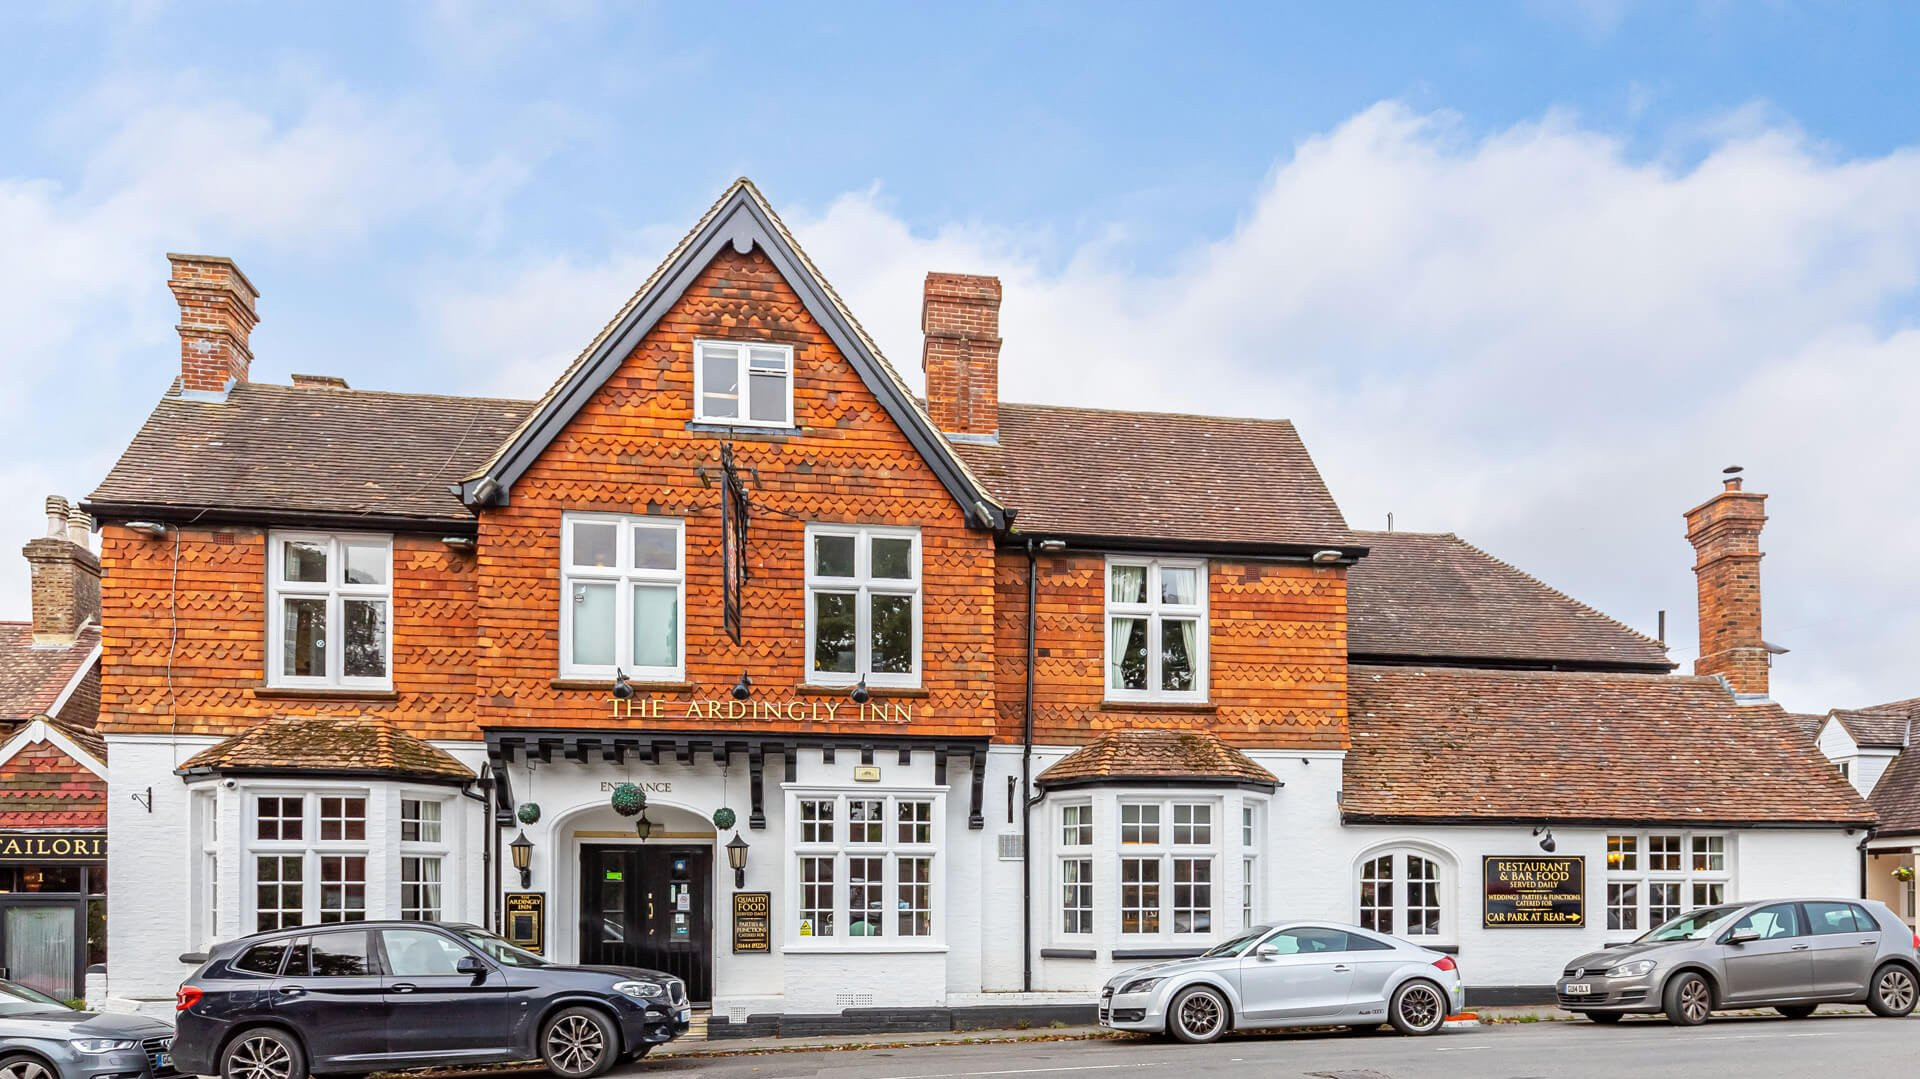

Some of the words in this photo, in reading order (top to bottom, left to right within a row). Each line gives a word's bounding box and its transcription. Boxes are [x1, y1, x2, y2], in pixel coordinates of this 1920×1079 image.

[606, 699, 665, 718] THE
[685, 700, 842, 722] ARDINGLY
[859, 703, 913, 723] INN
[0, 839, 108, 855] AILORI
[1498, 862, 1571, 872] RESTAURANT
[1499, 871, 1509, 881] &
[1511, 871, 1533, 881] BAR
[1536, 871, 1569, 881] FOOD
[738, 903, 766, 911] FOOD
[1487, 912, 1505, 921] CAR
[1507, 912, 1529, 921] PARK
[1531, 912, 1541, 921] AT
[1543, 912, 1565, 921] REAR
